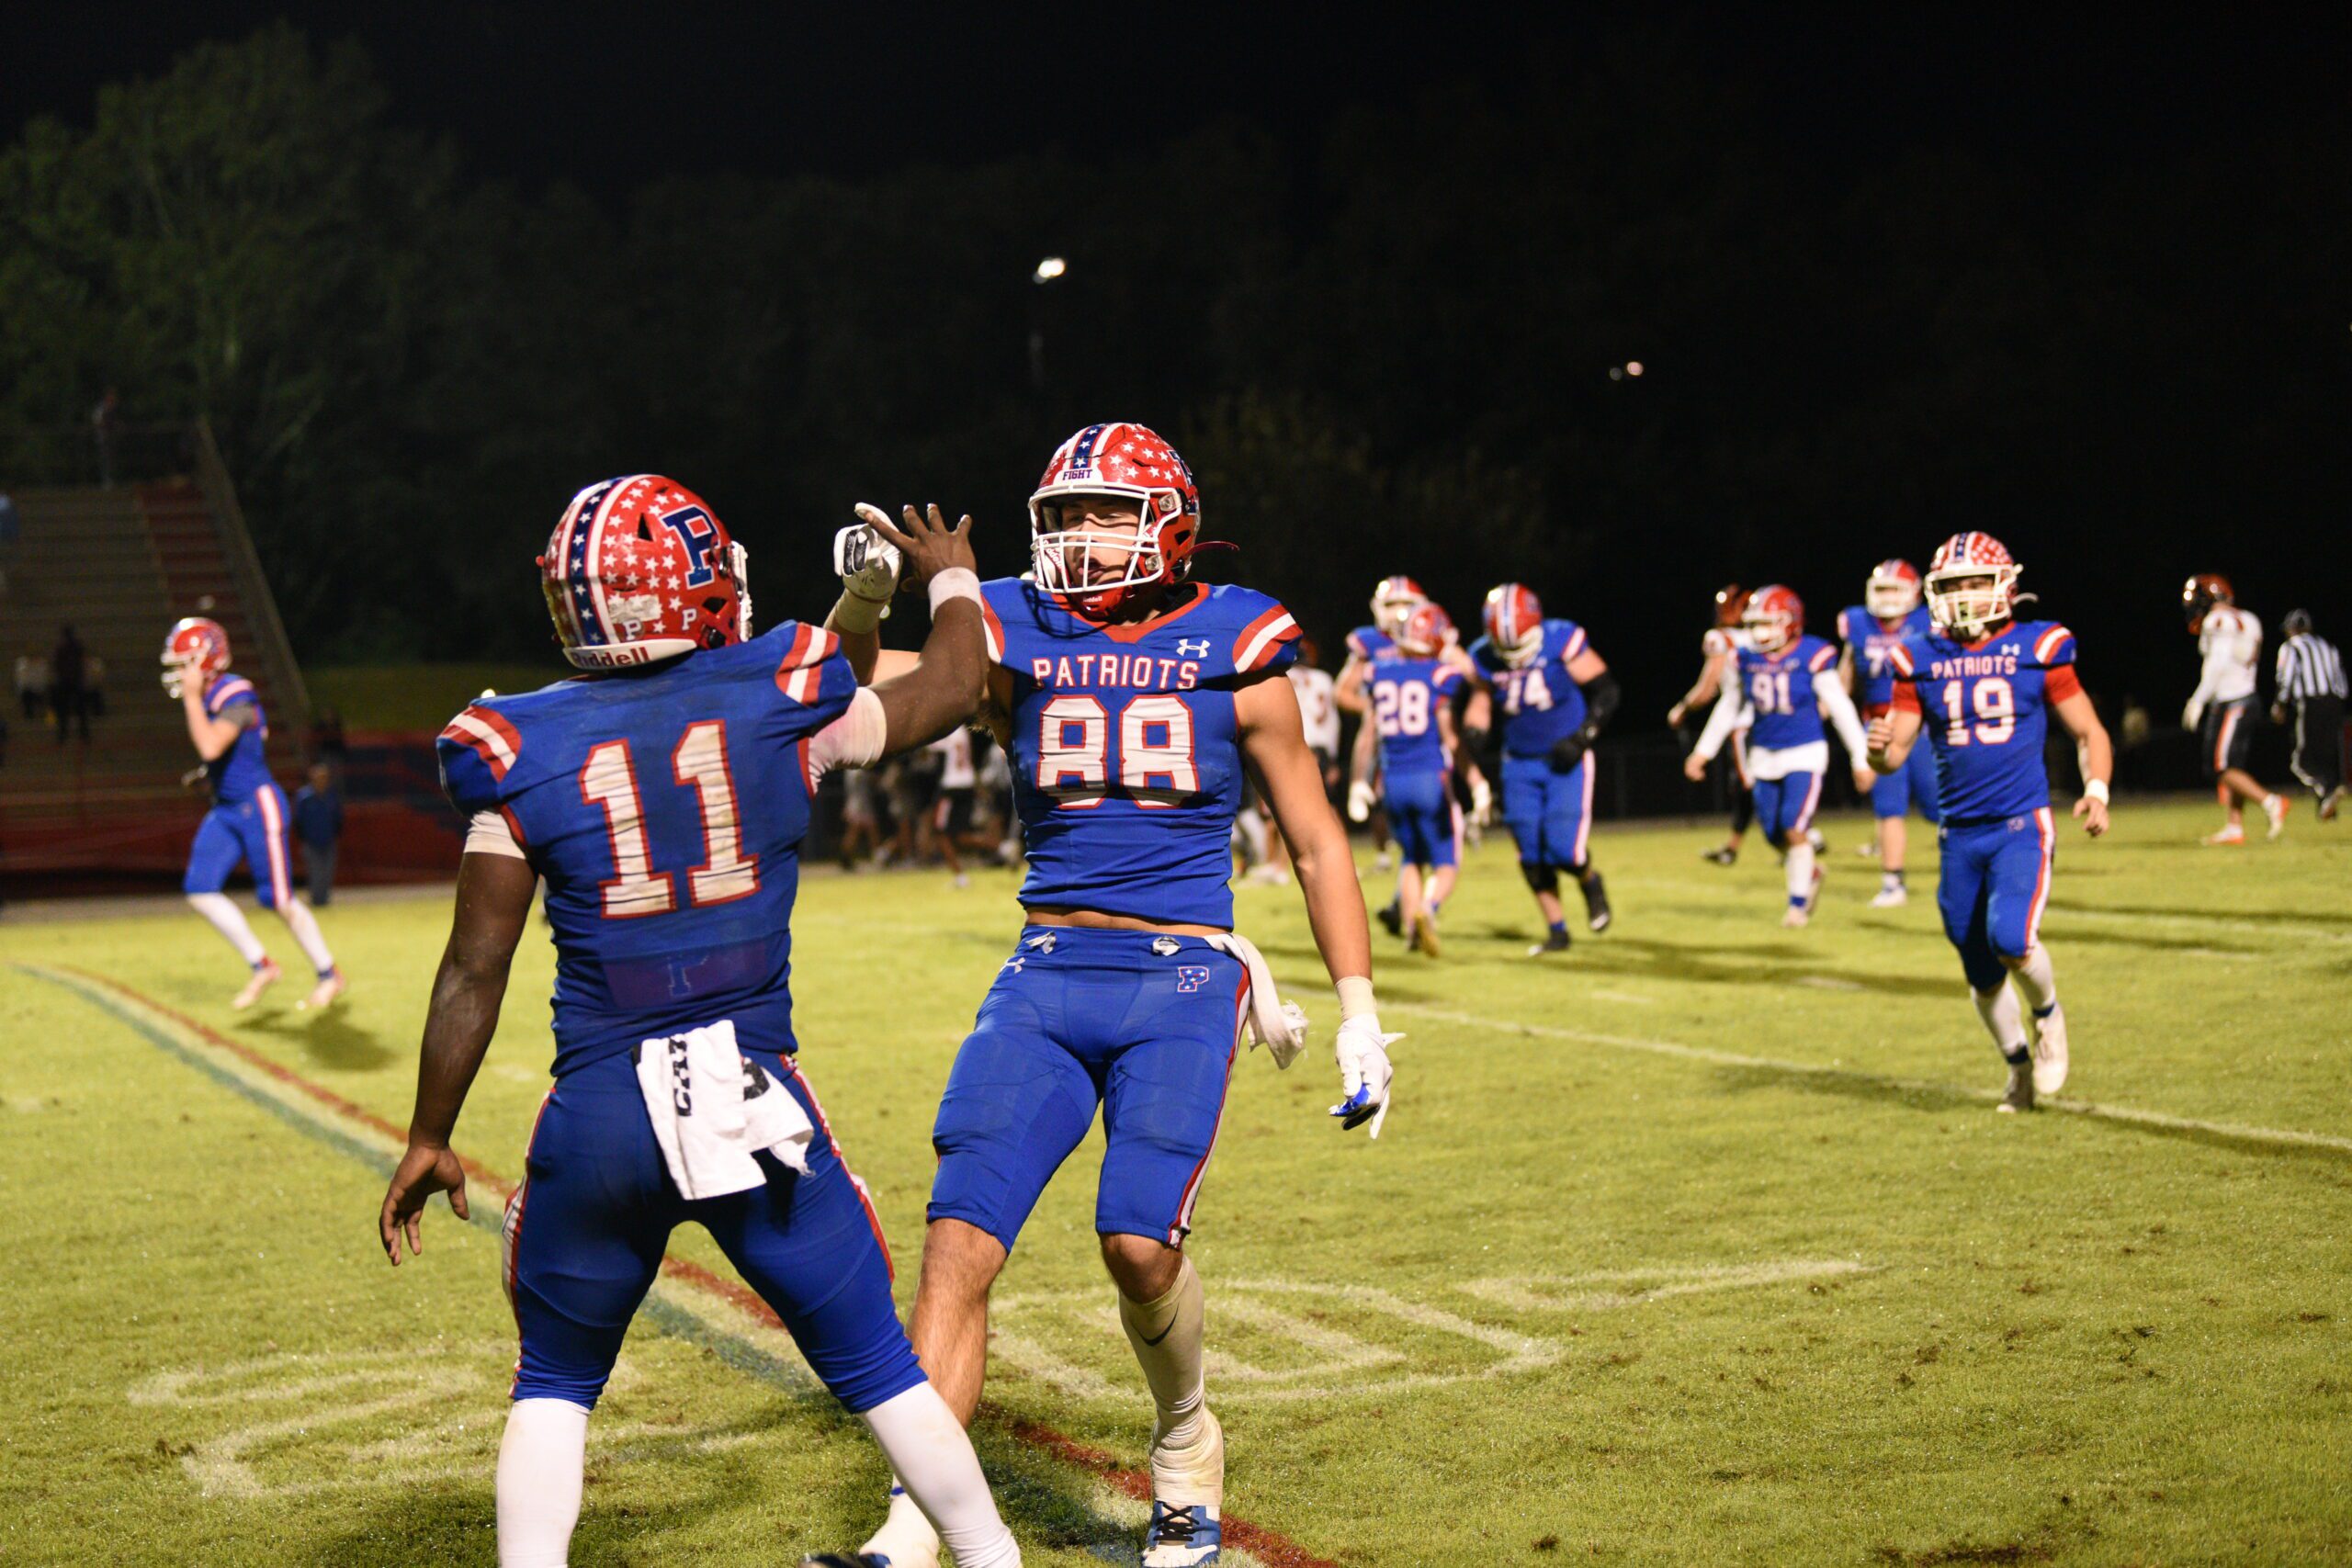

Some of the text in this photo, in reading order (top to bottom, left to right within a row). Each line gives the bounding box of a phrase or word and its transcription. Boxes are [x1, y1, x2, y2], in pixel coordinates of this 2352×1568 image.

[1062, 468, 1093, 481] FIGHT
[659, 503, 722, 591] P
[622, 616, 642, 641] P
[682, 607, 698, 631] P
[1032, 654, 1200, 691] PATRIOTS
[1930, 656, 2018, 681] PATRIOTS
[1373, 680, 1430, 736] 28
[1751, 671, 1795, 716] 91
[1942, 677, 2017, 747] 19
[1036, 694, 1201, 809] 88
[577, 719, 762, 919] 11
[1177, 965, 1210, 993] P
